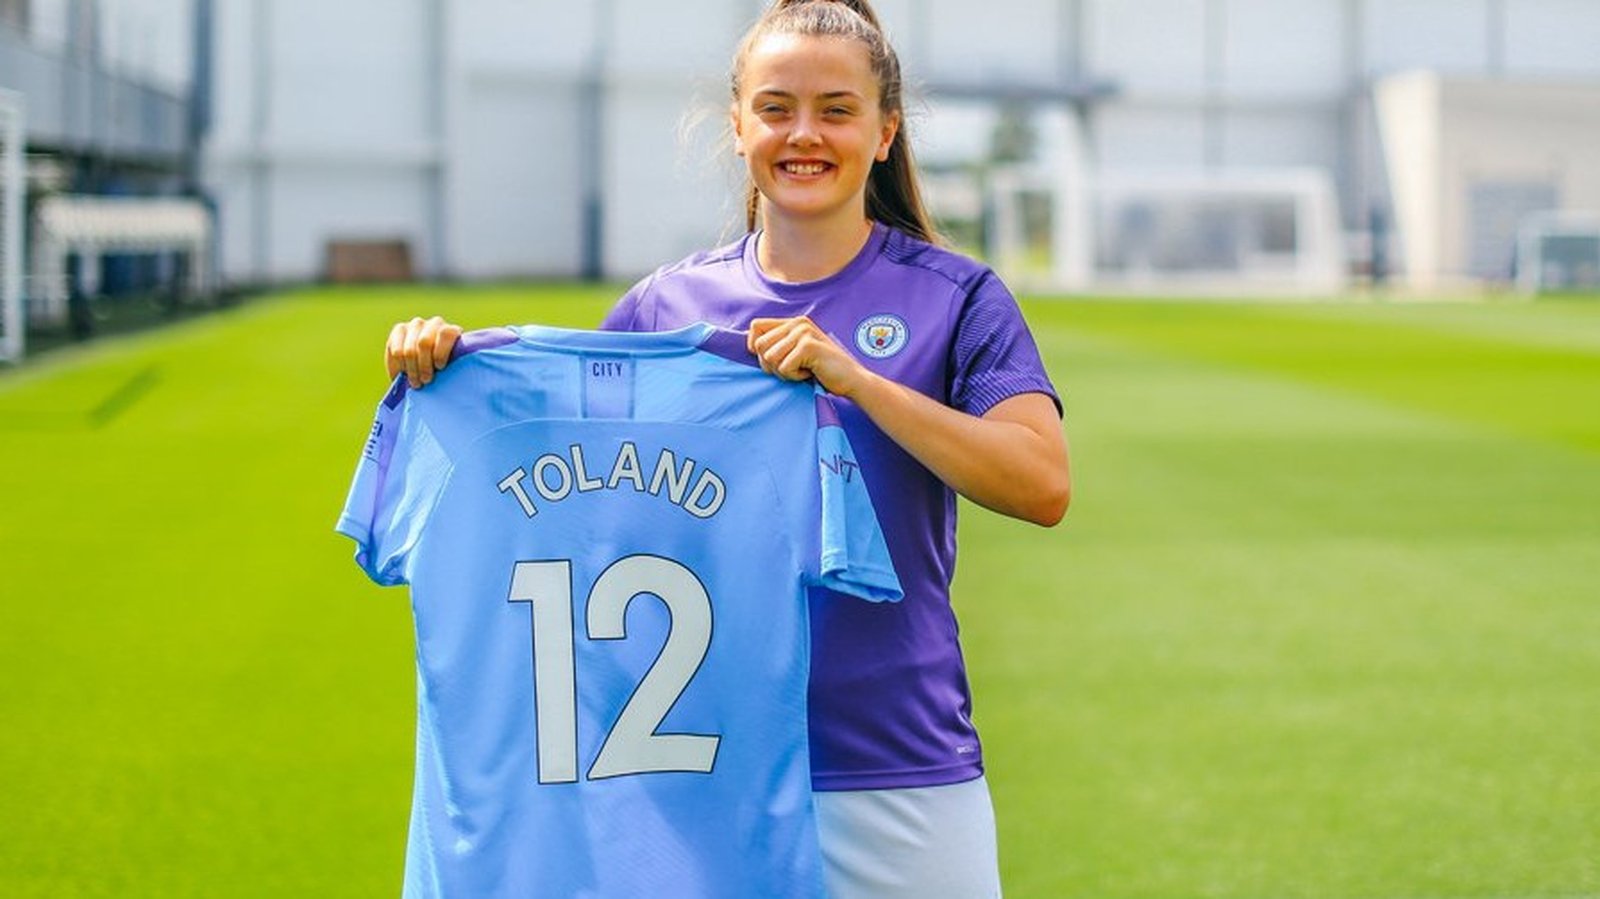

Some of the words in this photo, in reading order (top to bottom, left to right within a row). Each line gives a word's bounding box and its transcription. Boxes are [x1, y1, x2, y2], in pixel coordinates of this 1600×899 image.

[592, 362, 622, 377] CITY
[497, 441, 727, 519] TOLAND
[507, 553, 722, 785] 12
